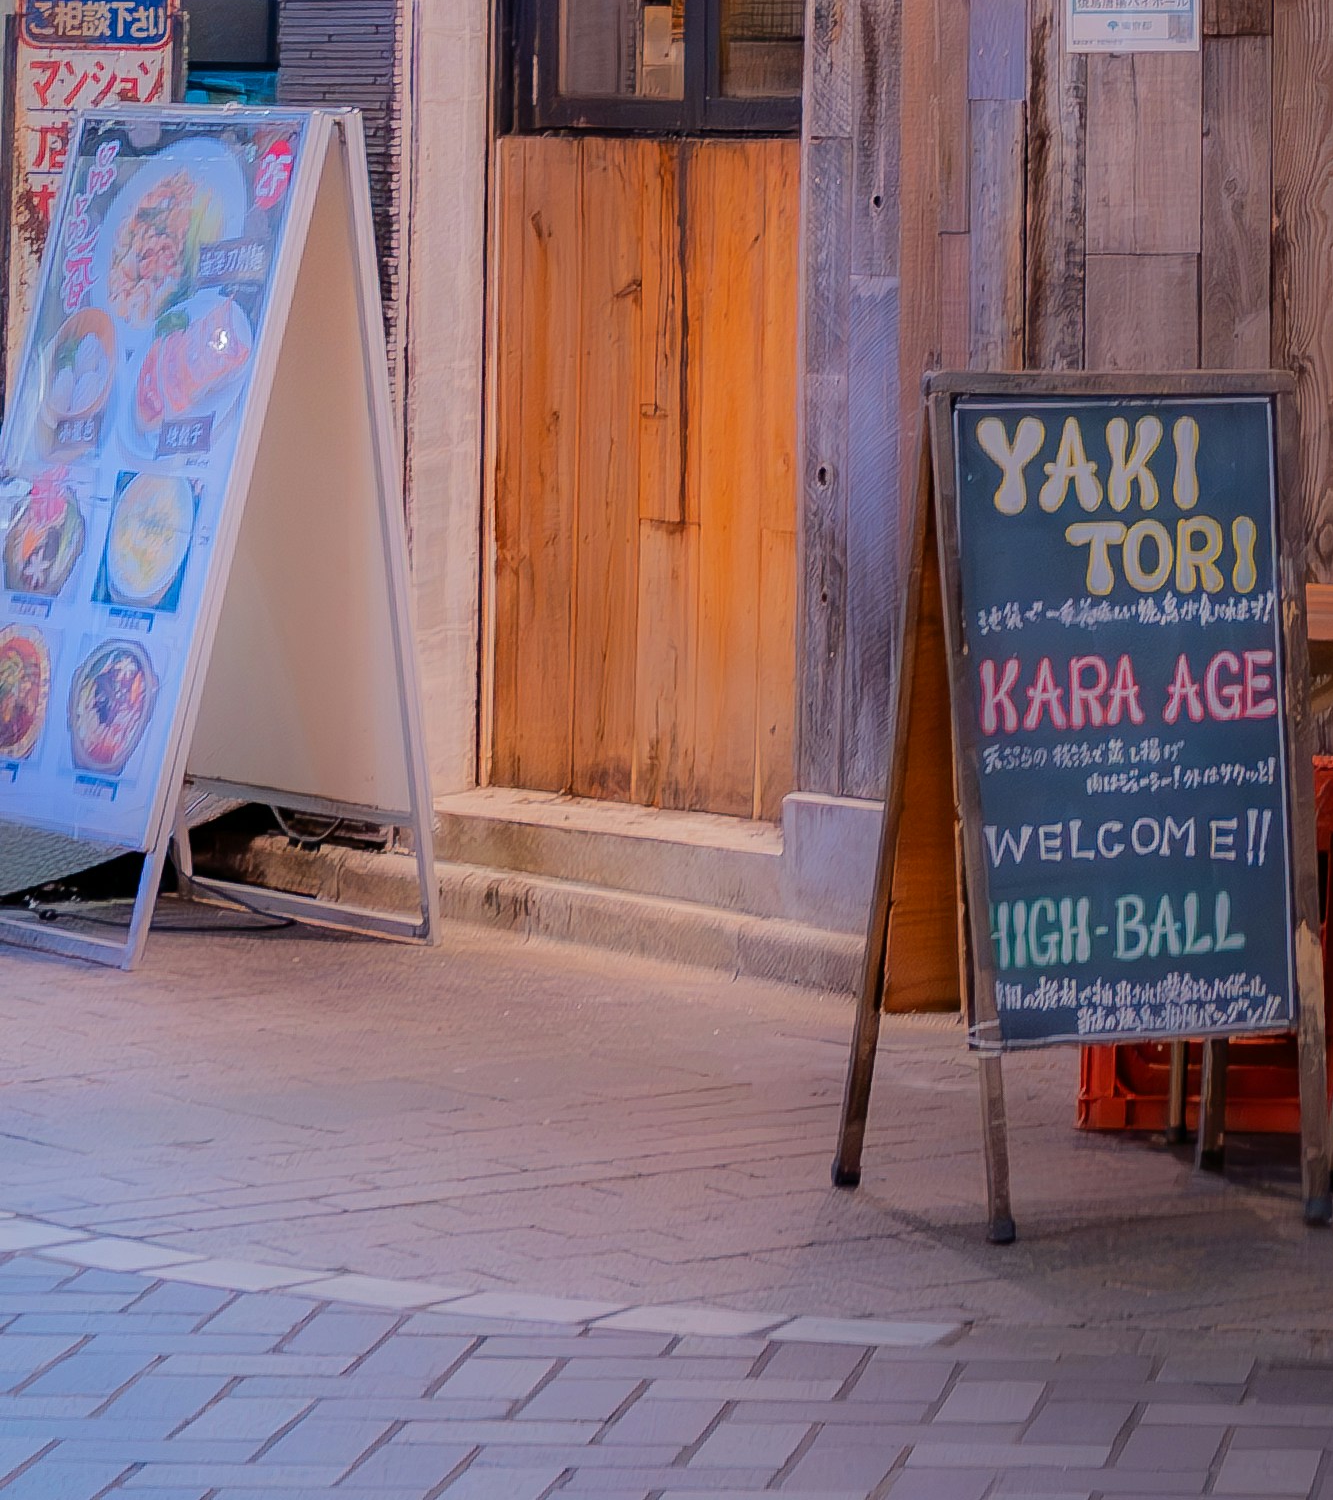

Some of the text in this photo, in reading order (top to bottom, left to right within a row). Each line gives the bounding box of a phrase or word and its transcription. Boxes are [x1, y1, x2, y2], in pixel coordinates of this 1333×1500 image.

[28, 2, 166, 39] ご相談下さい
[29, 59, 166, 108] マンション
[256, 153, 293, 198] 2F
[975, 414, 1200, 516] YAKI
[1065, 514, 1259, 597] TORI
[979, 649, 1278, 737] KARA AGE
[985, 808, 1272, 870] WELCOME!!
[988, 890, 1248, 971] HIGH-BALL
